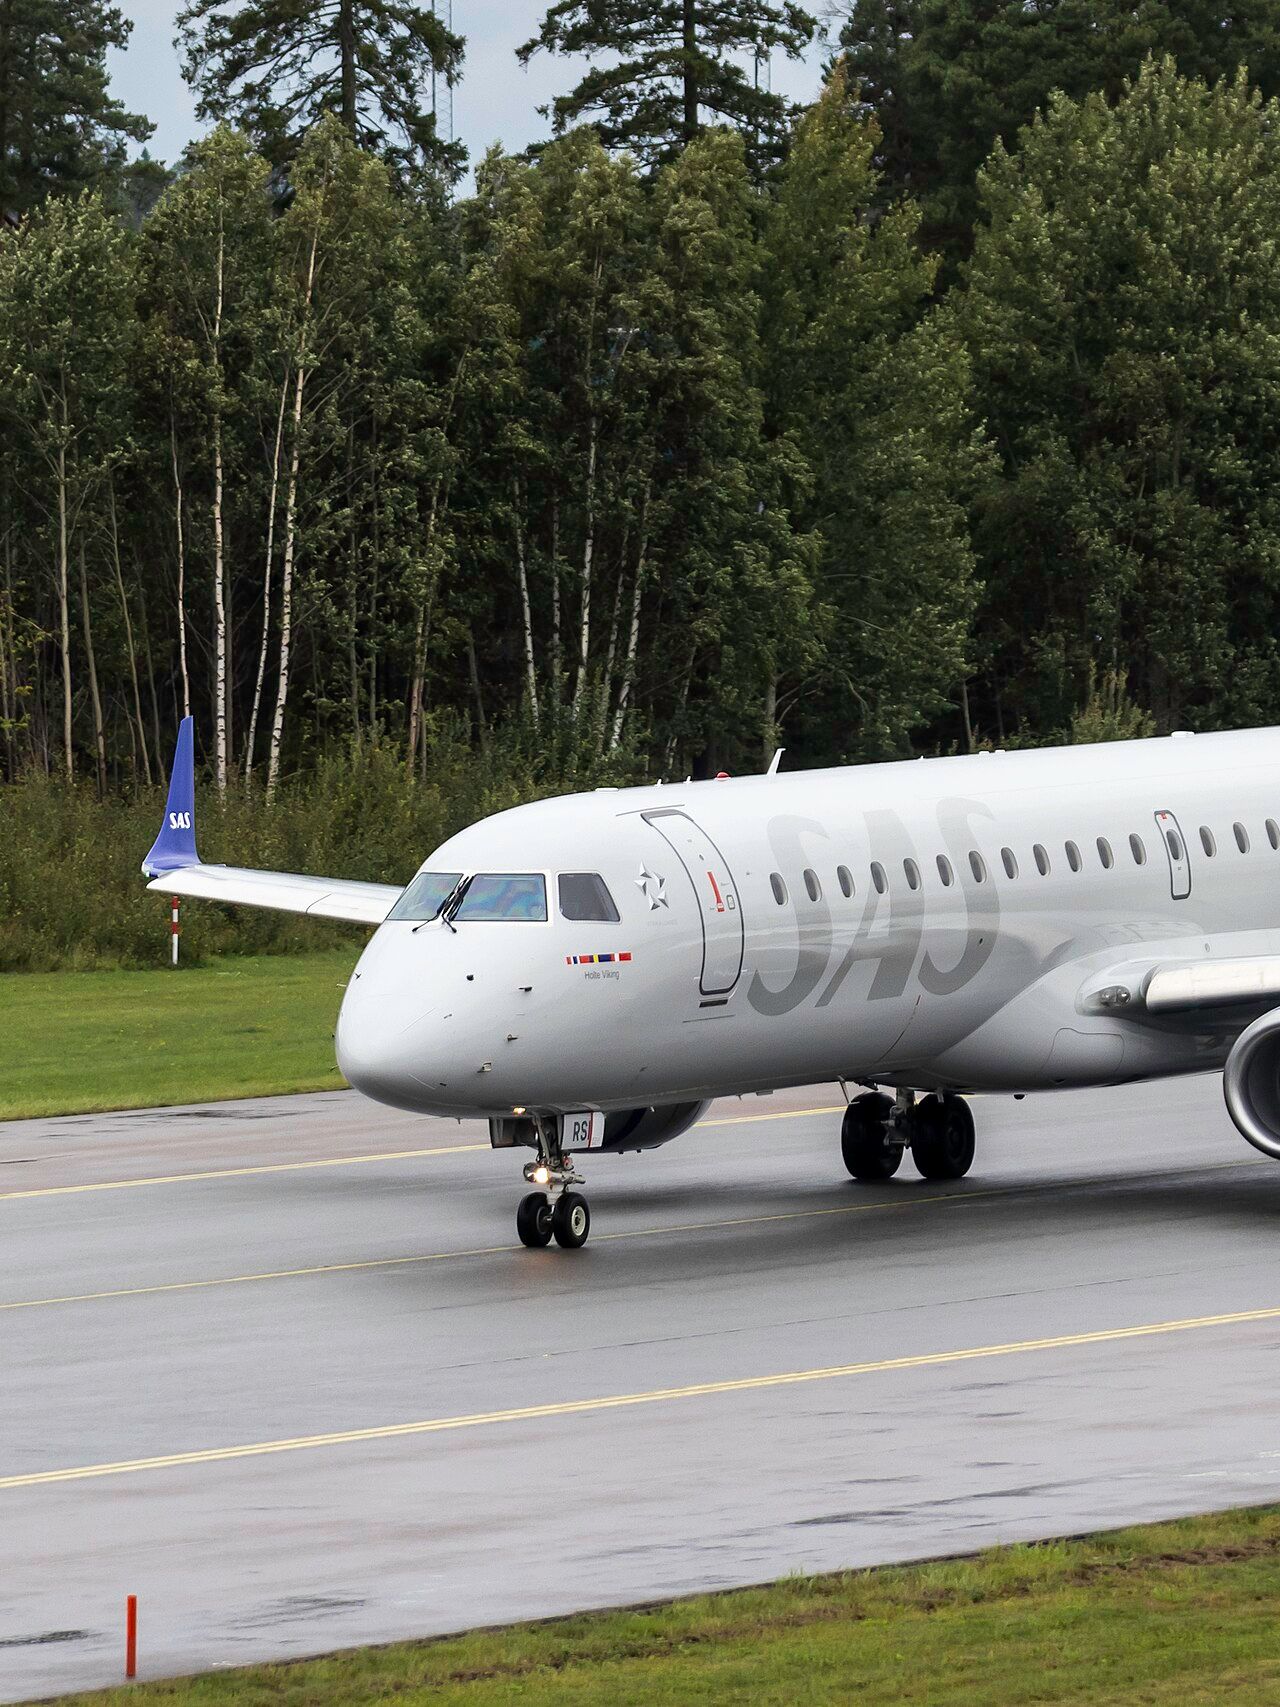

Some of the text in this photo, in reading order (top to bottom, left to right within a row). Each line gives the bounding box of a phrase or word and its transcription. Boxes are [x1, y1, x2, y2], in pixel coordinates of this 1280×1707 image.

[169, 812, 191, 829] SAS
[747, 798, 1000, 1017] SAS
[573, 1120, 591, 1141] RSI
